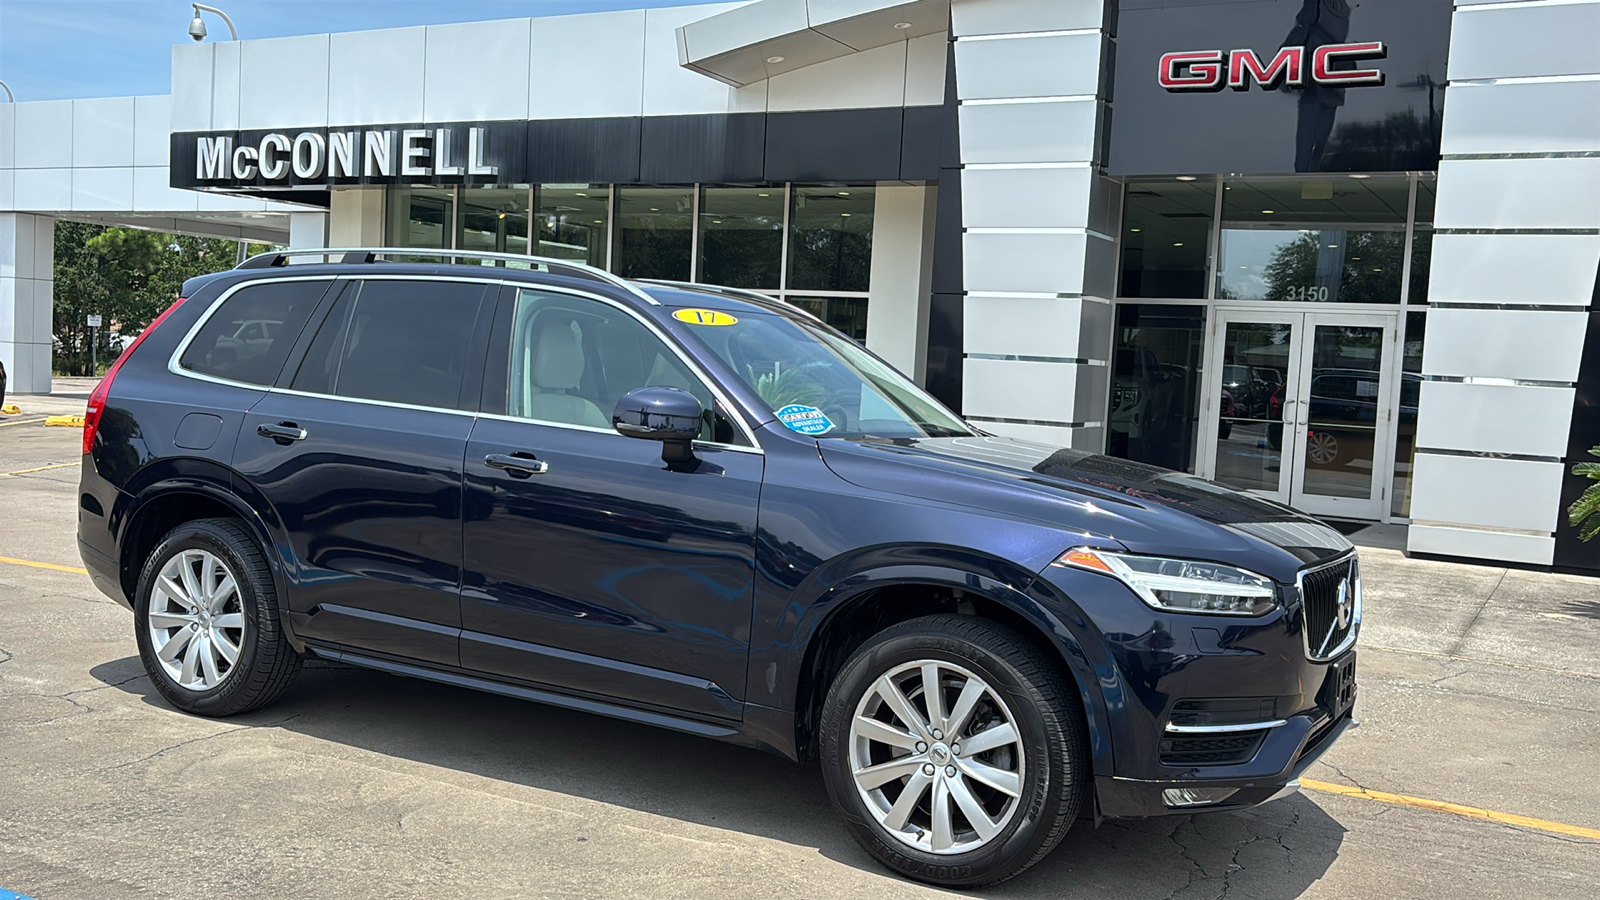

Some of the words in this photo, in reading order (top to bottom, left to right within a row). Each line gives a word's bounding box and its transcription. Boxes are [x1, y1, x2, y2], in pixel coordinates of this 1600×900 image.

[1158, 41, 1386, 92] GMC
[196, 127, 498, 180] McCONNELL
[1286, 285, 1328, 301] 3150
[696, 311, 715, 324] 17
